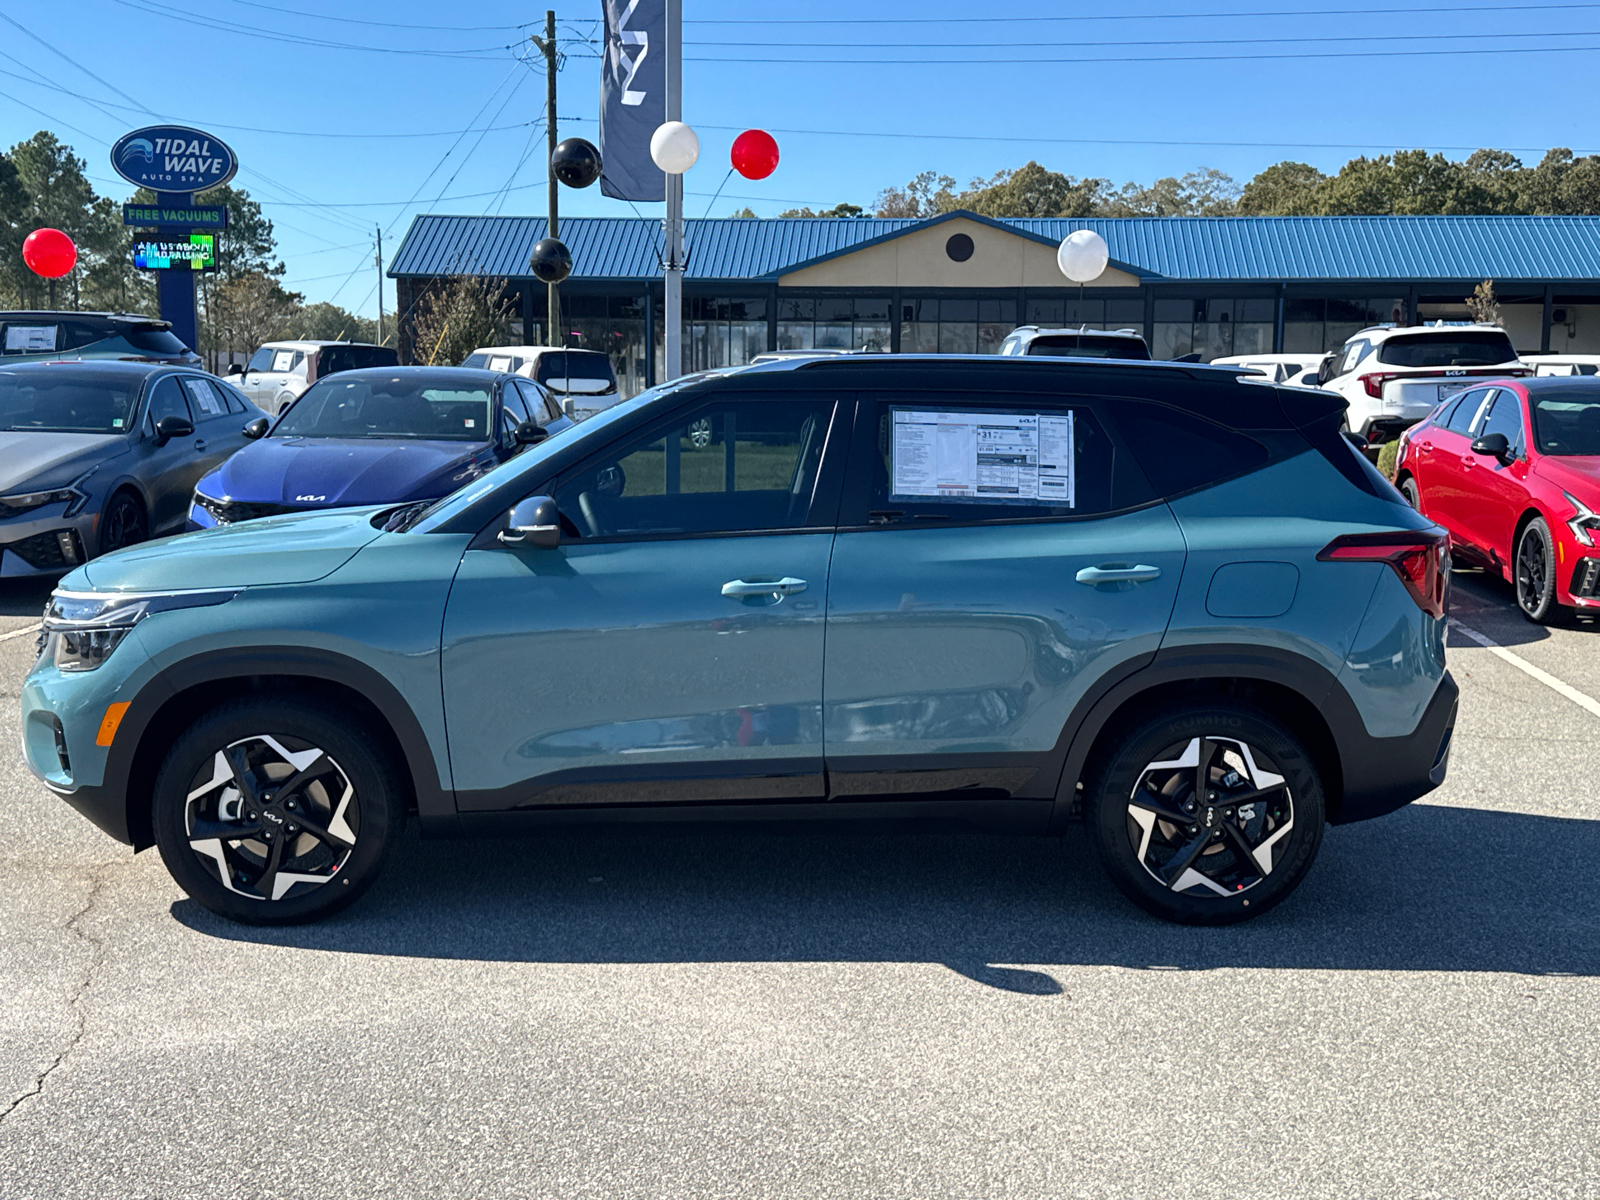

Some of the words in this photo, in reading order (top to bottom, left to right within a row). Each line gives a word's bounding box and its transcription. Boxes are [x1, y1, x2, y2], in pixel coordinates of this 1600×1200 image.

[154, 138, 211, 157] TIDAL
[164, 156, 223, 174] WAVE
[141, 173, 172, 181] AUTO
[128, 208, 160, 221] FREE
[163, 209, 219, 223] VACUUMS
[982, 431, 992, 439] 31
[295, 494, 327, 503] KIA
[1169, 715, 1243, 733] KUMHO
[262, 810, 283, 825] KIA
